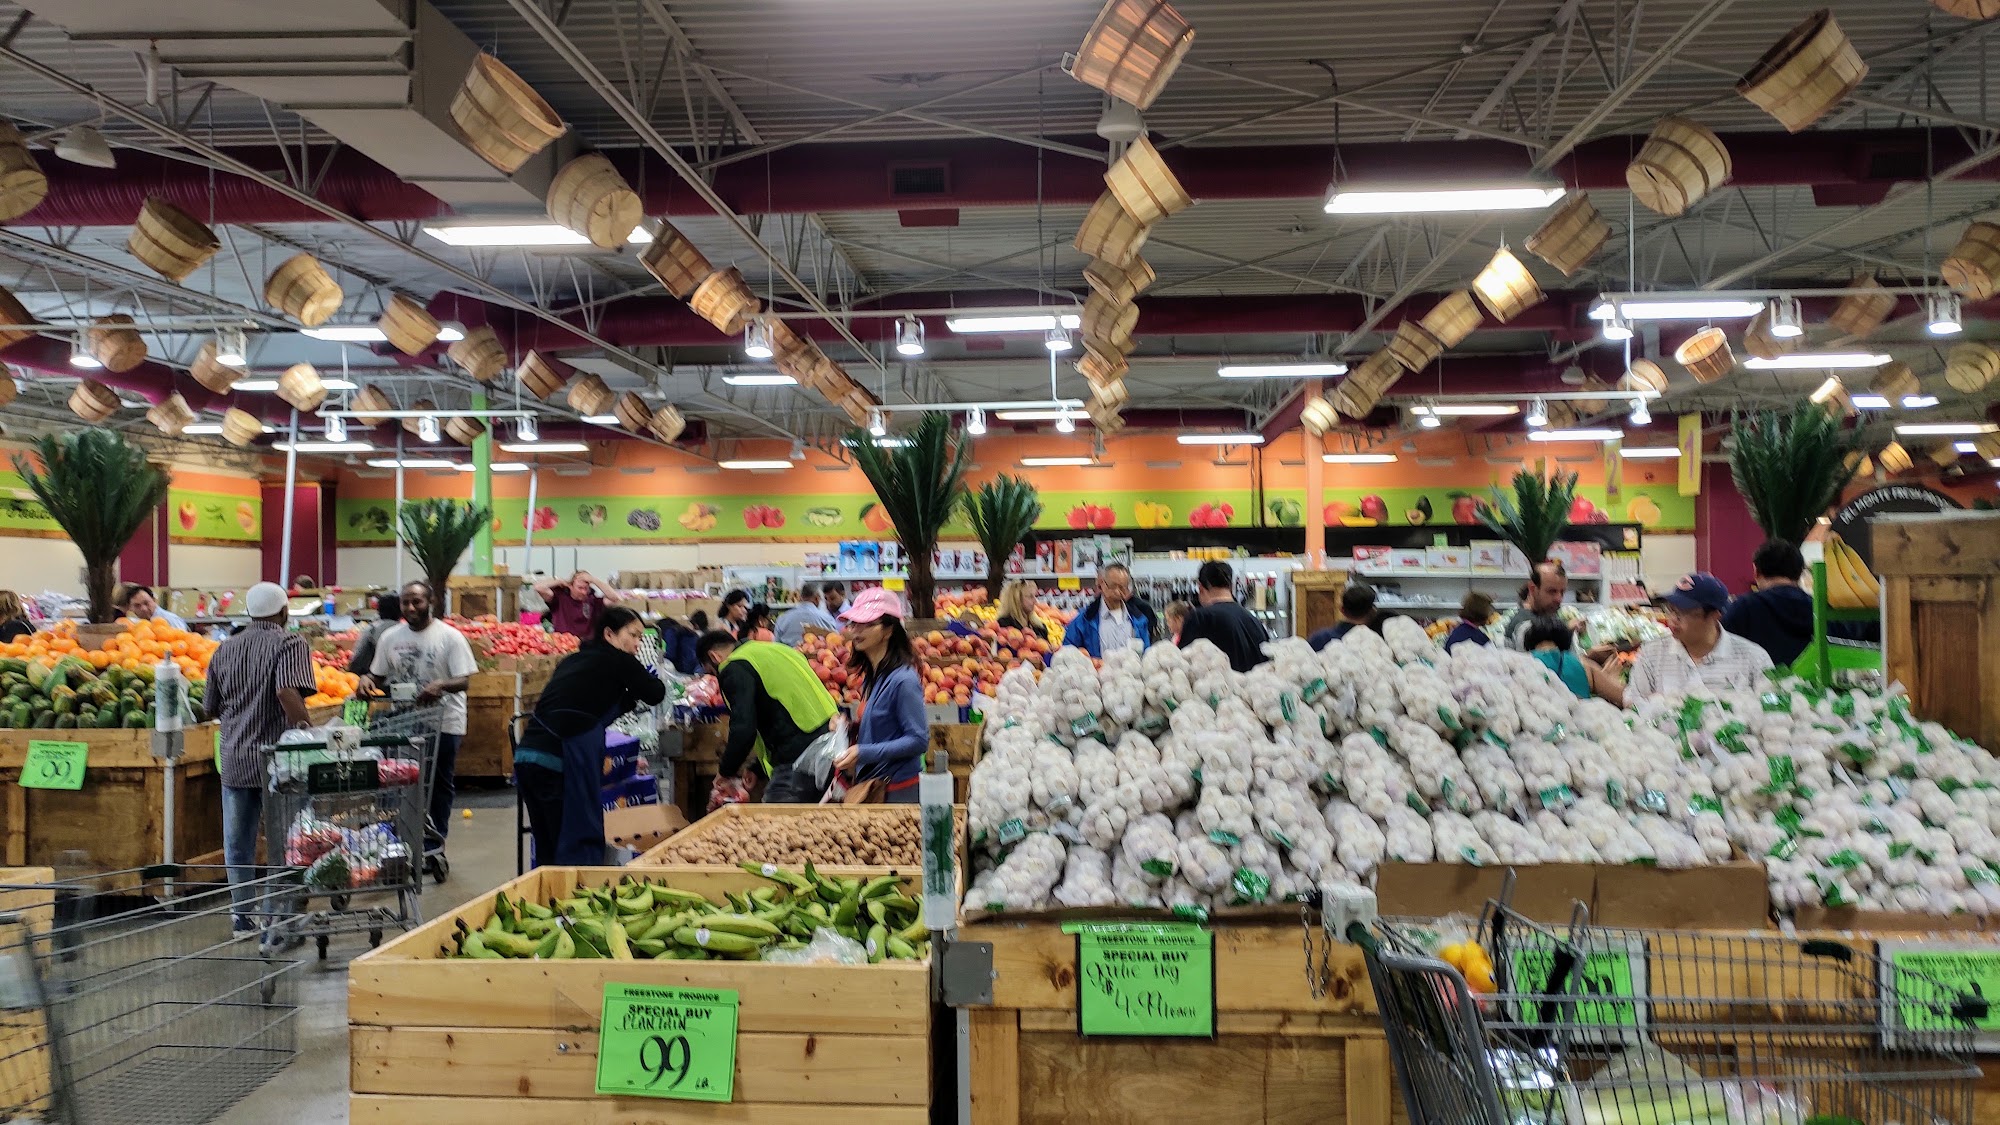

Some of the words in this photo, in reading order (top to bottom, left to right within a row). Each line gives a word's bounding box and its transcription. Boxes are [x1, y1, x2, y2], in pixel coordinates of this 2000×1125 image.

[1839, 505, 1859, 525] DEL
[1854, 488, 1891, 511] MONTE
[1096, 935, 1149, 945] FREESTONE
[1153, 935, 1196, 946] PRODUCE
[1103, 950, 1158, 962] SPECIAL
[1161, 951, 1189, 963] BUY
[623, 988, 674, 998] FREESTONE
[628, 1004, 680, 1018] SPECIAL
[686, 1007, 712, 1020] BUY
[640, 1034, 691, 1090] 99
